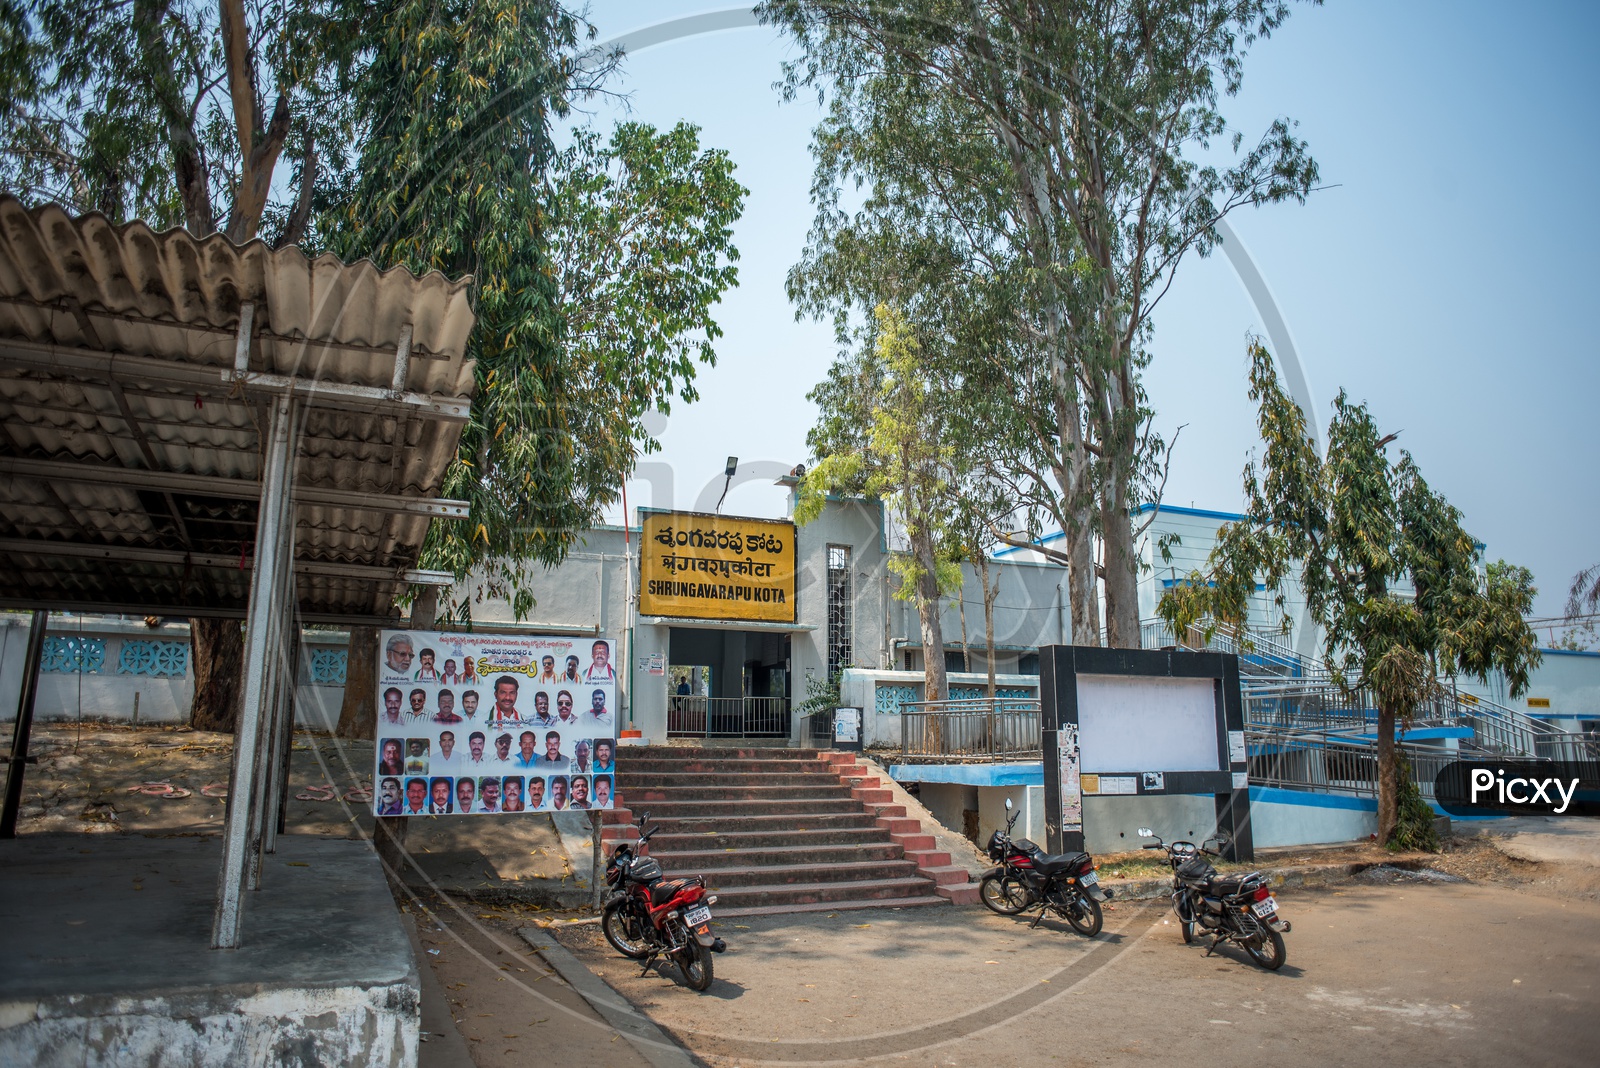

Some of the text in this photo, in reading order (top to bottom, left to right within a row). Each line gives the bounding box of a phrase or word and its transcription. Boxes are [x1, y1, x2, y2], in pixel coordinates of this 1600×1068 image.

[654, 526, 783, 555] శృంగవరపు కోట
[648, 580, 786, 604] SHRUNGAVARAPU KOTA
